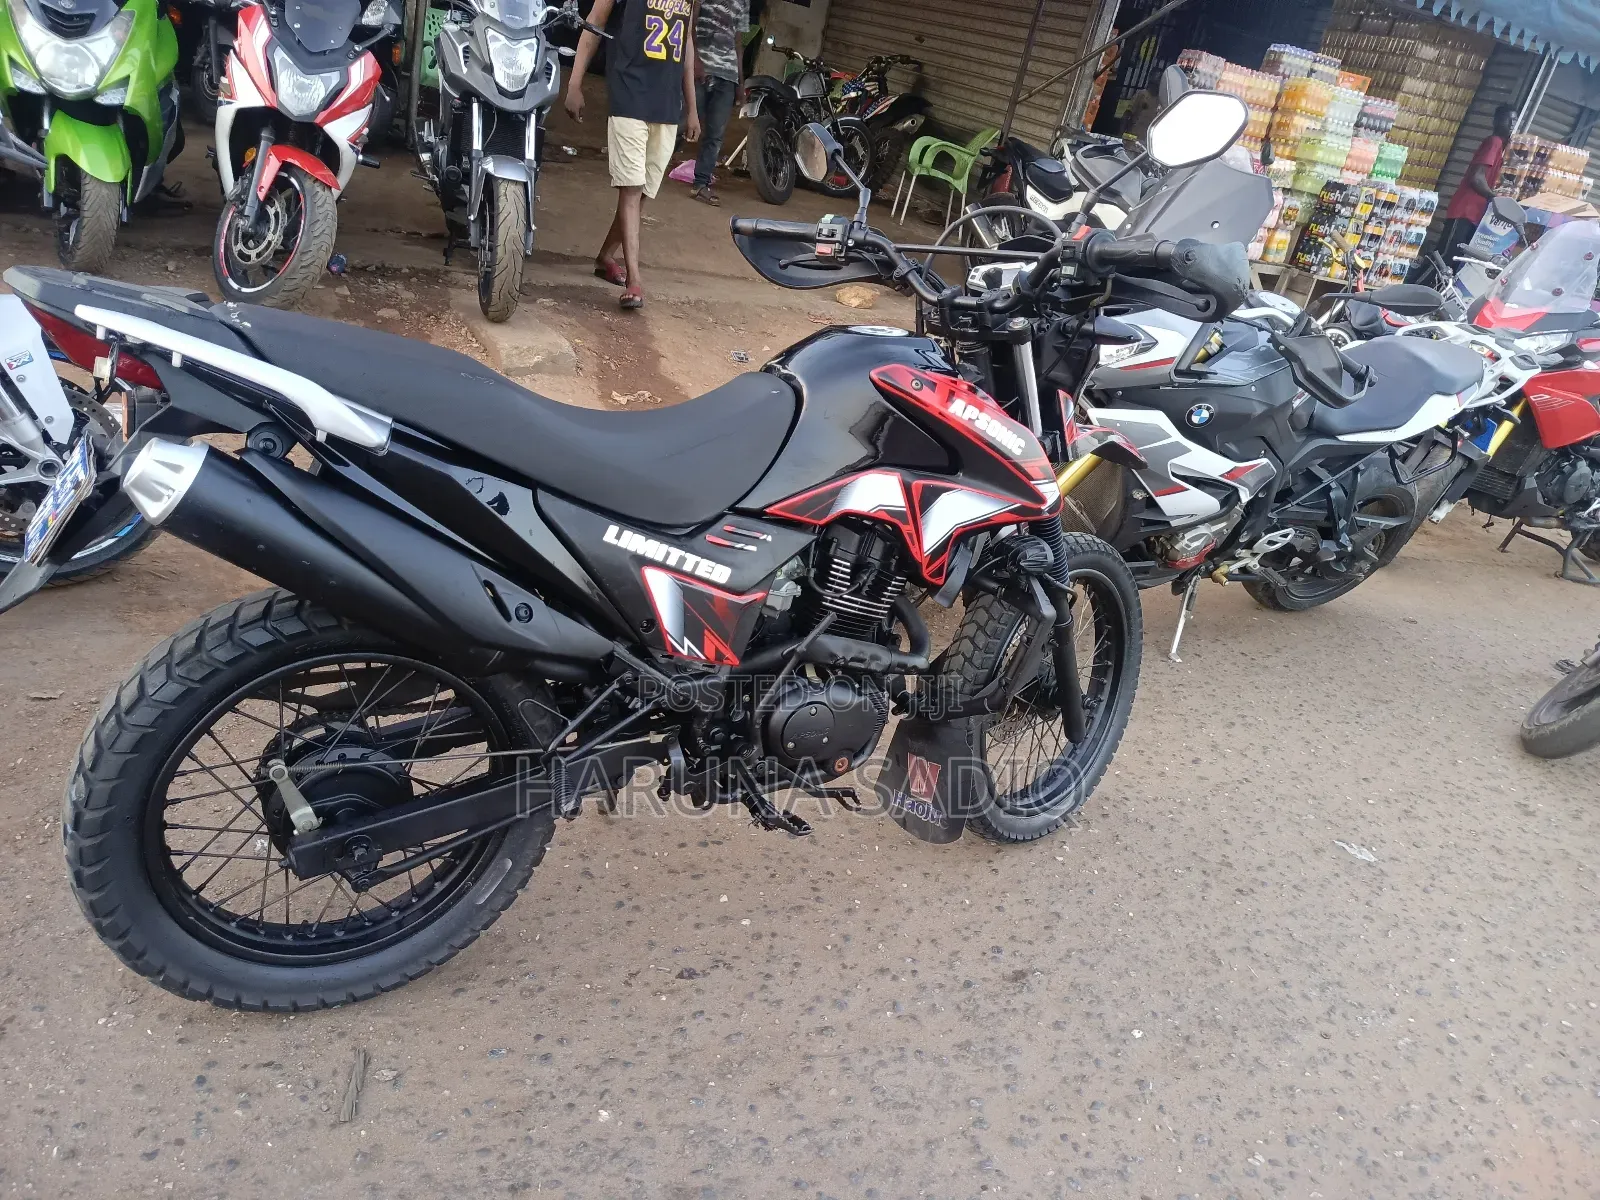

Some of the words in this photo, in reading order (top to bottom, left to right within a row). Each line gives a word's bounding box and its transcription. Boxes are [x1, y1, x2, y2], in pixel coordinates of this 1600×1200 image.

[644, 15, 685, 62] 24
[948, 398, 1026, 455] APSONIC
[602, 524, 732, 584] LIMITTED
